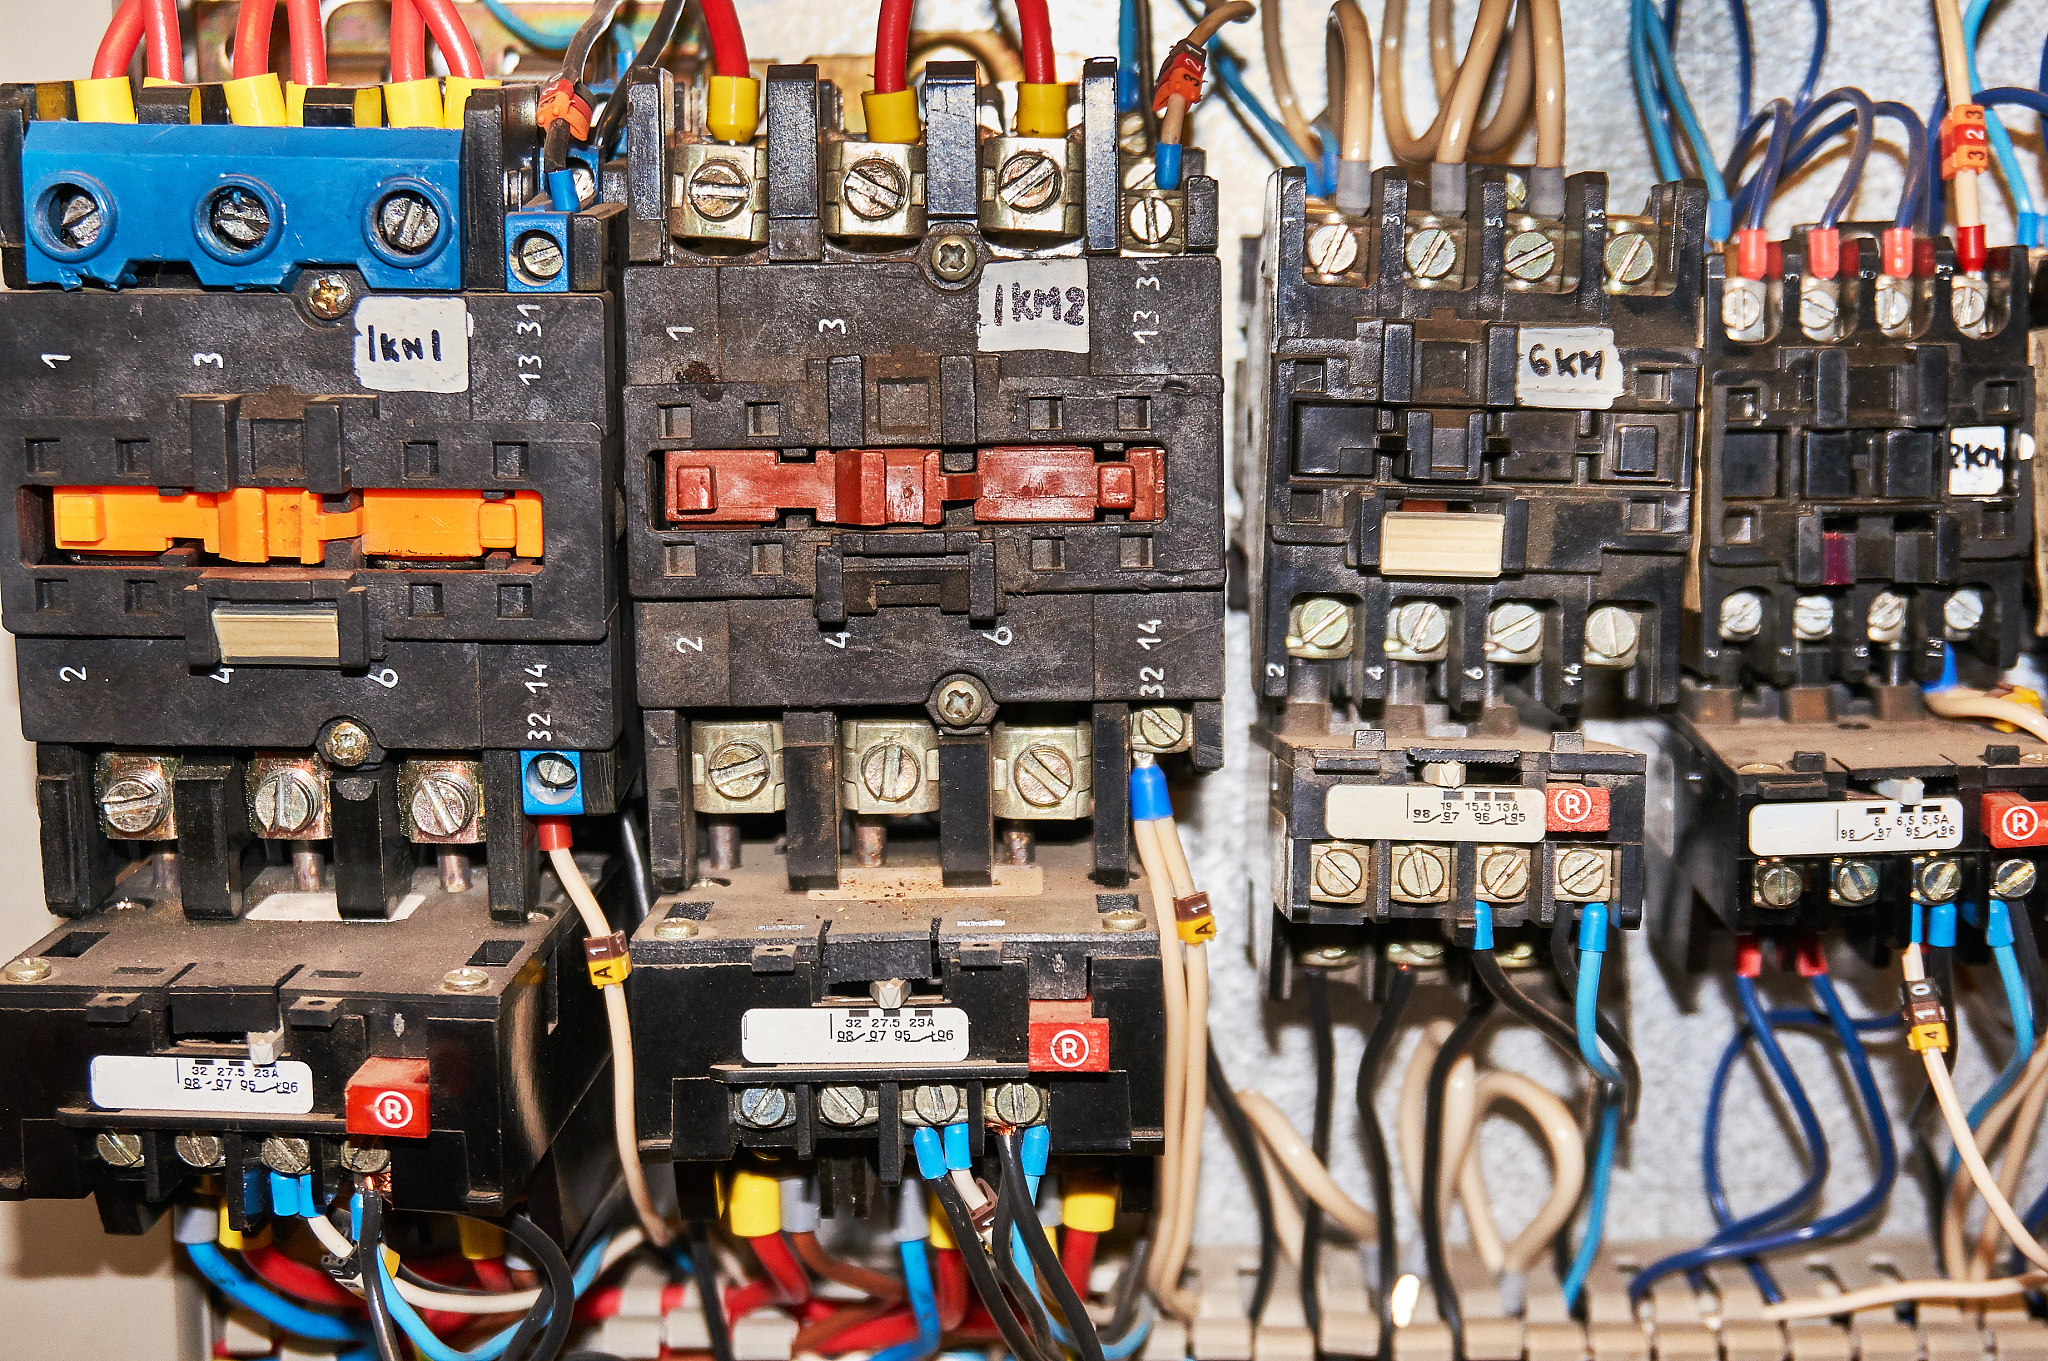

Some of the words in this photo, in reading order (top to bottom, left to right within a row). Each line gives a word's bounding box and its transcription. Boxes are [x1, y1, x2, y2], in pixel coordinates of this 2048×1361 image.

[1381, 213, 1401, 228] 3
[516, 304, 543, 338] 31
[818, 318, 846, 335] 3
[666, 326, 696, 342] 1
[41, 353, 72, 369] 1
[193, 352, 224, 369] 3
[517, 354, 542, 386] 13
[825, 632, 851, 649] 4
[982, 626, 1013, 646] 6
[1136, 619, 1162, 651] 14
[676, 637, 703, 654] 2
[59, 666, 87, 683] 2
[210, 668, 235, 684] 4
[1265, 662, 1285, 677] 2
[1366, 666, 1385, 681] 4
[1464, 666, 1484, 680] 6
[1562, 663, 1582, 686] 14
[367, 668, 399, 689] 6
[523, 664, 549, 694] 14
[1138, 666, 1164, 699] 32
[526, 713, 552, 742] 32
[1441, 802, 1452, 811] 19
[1465, 802, 1491, 812] 15.5
[1413, 809, 1431, 819] 98
[1443, 812, 1460, 821] 97
[1474, 813, 1490, 822] 96
[1509, 813, 1527, 823] 95
[1874, 816, 1881, 827] 8
[1841, 829, 1856, 839] 98
[1878, 828, 1893, 838] 97
[1906, 827, 1921, 837] 95
[1940, 826, 1956, 836] 96
[845, 1018, 861, 1028] 32
[871, 1018, 900, 1028] 27.5
[909, 1017, 935, 1028] 23A
[837, 1031, 854, 1041] 98
[869, 1031, 887, 1041] 97
[894, 1031, 911, 1042] 95
[937, 1030, 954, 1041] 96
[192, 1066, 207, 1076] 32
[216, 1067, 246, 1078] 27.5
[184, 1077, 200, 1088] 98
[215, 1079, 232, 1090] 97
[240, 1080, 256, 1091] 95
[282, 1082, 298, 1093] 96
